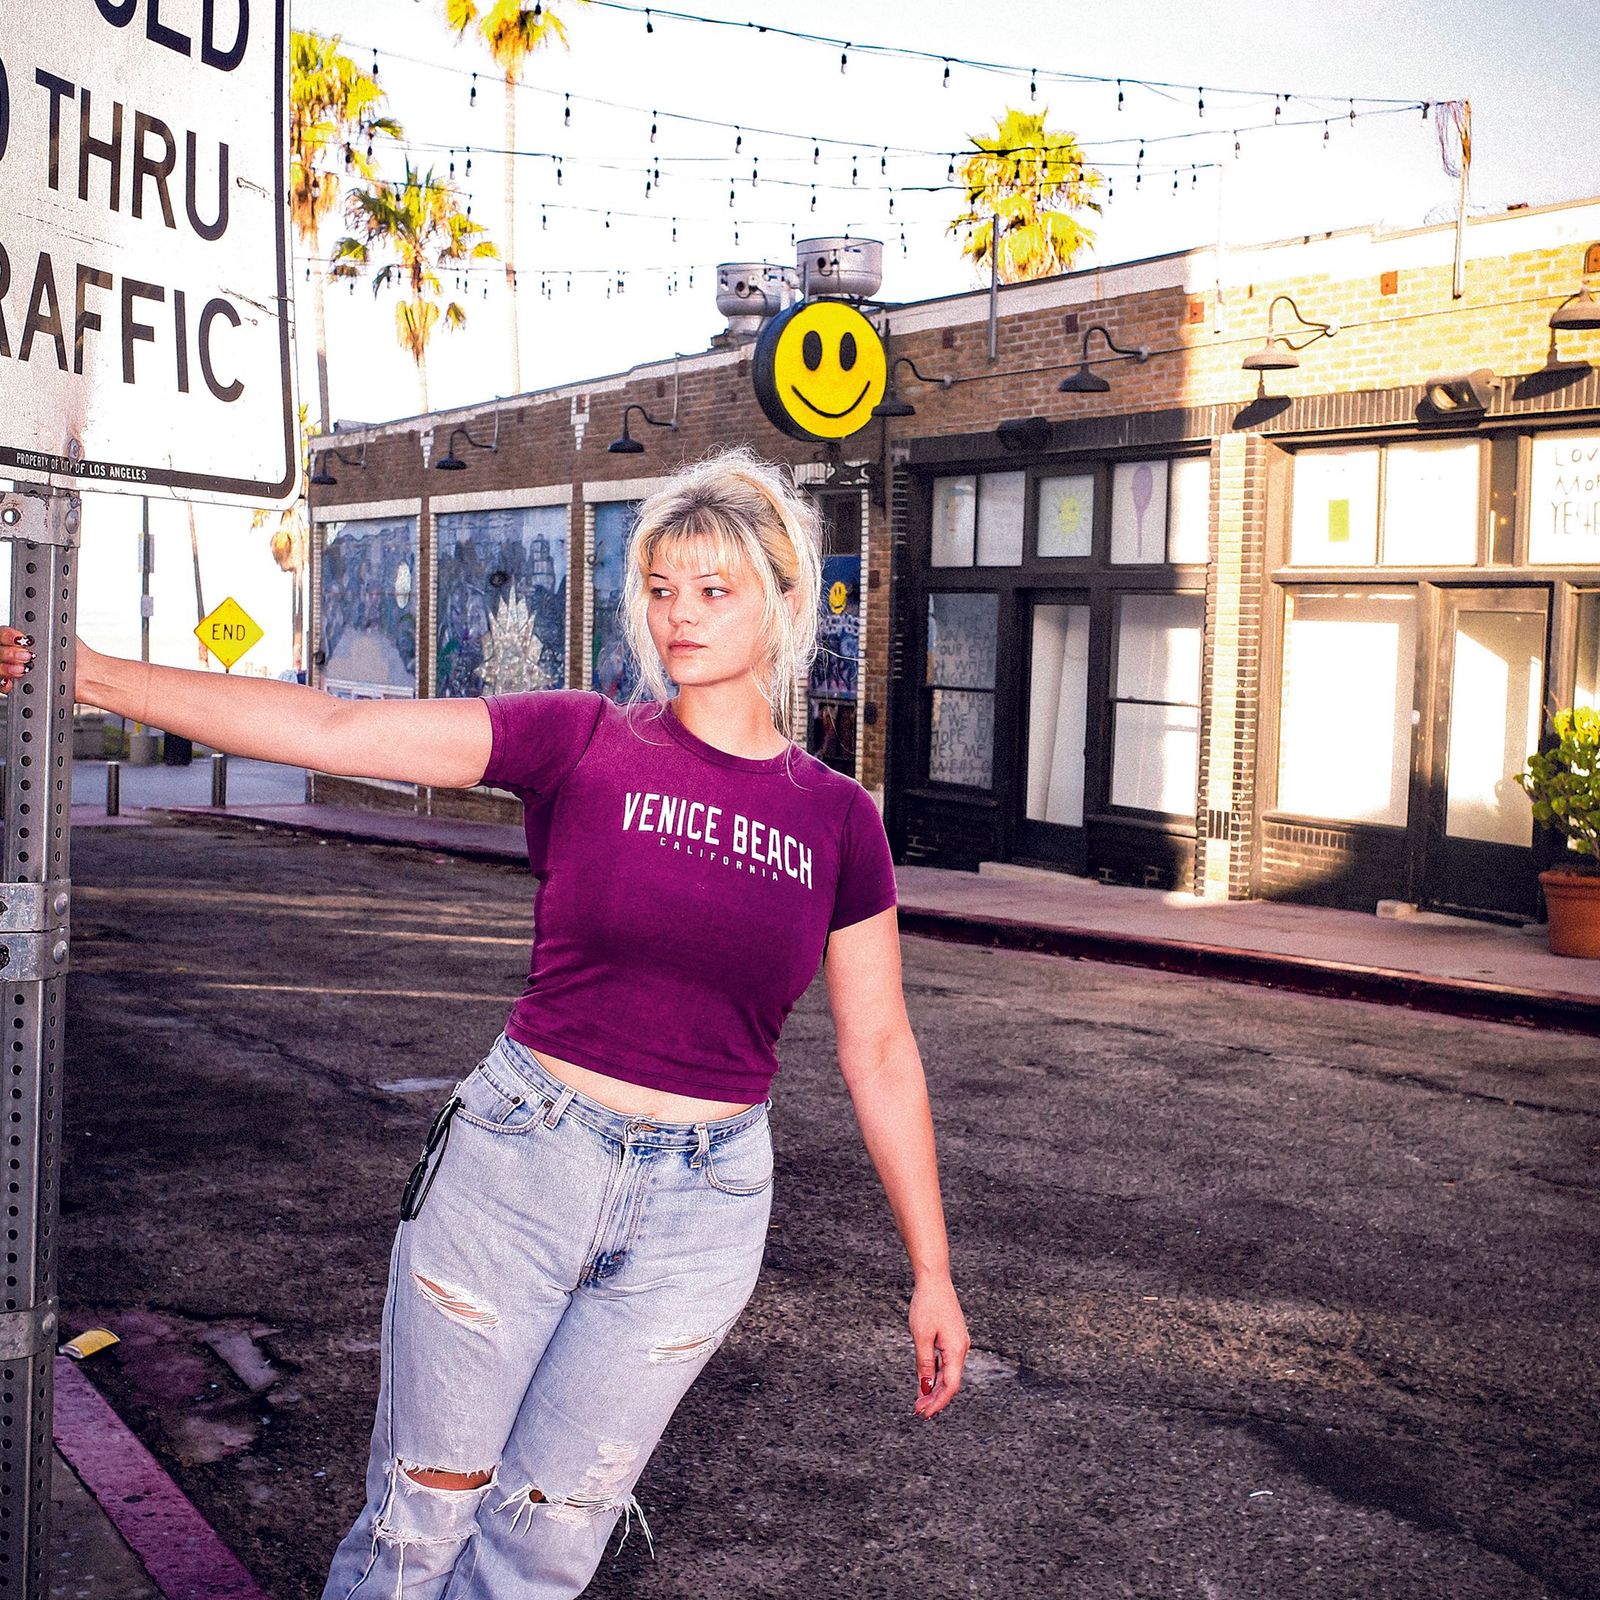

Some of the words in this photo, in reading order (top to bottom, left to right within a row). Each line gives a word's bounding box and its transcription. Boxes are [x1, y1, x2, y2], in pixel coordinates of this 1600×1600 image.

[36, 67, 229, 242] THRU
[0, 241, 244, 403] AFFIC
[16, 452, 49, 468] PROPERTY
[51, 458, 59, 470] OF
[75, 462, 86, 474] OF
[89, 464, 106, 477] LOS
[109, 465, 147, 481] ANGELES
[212, 623, 246, 641] END
[622, 792, 723, 846] VENICE
[732, 814, 813, 890] BEACH
[659, 836, 779, 881] CALIFORNIA
